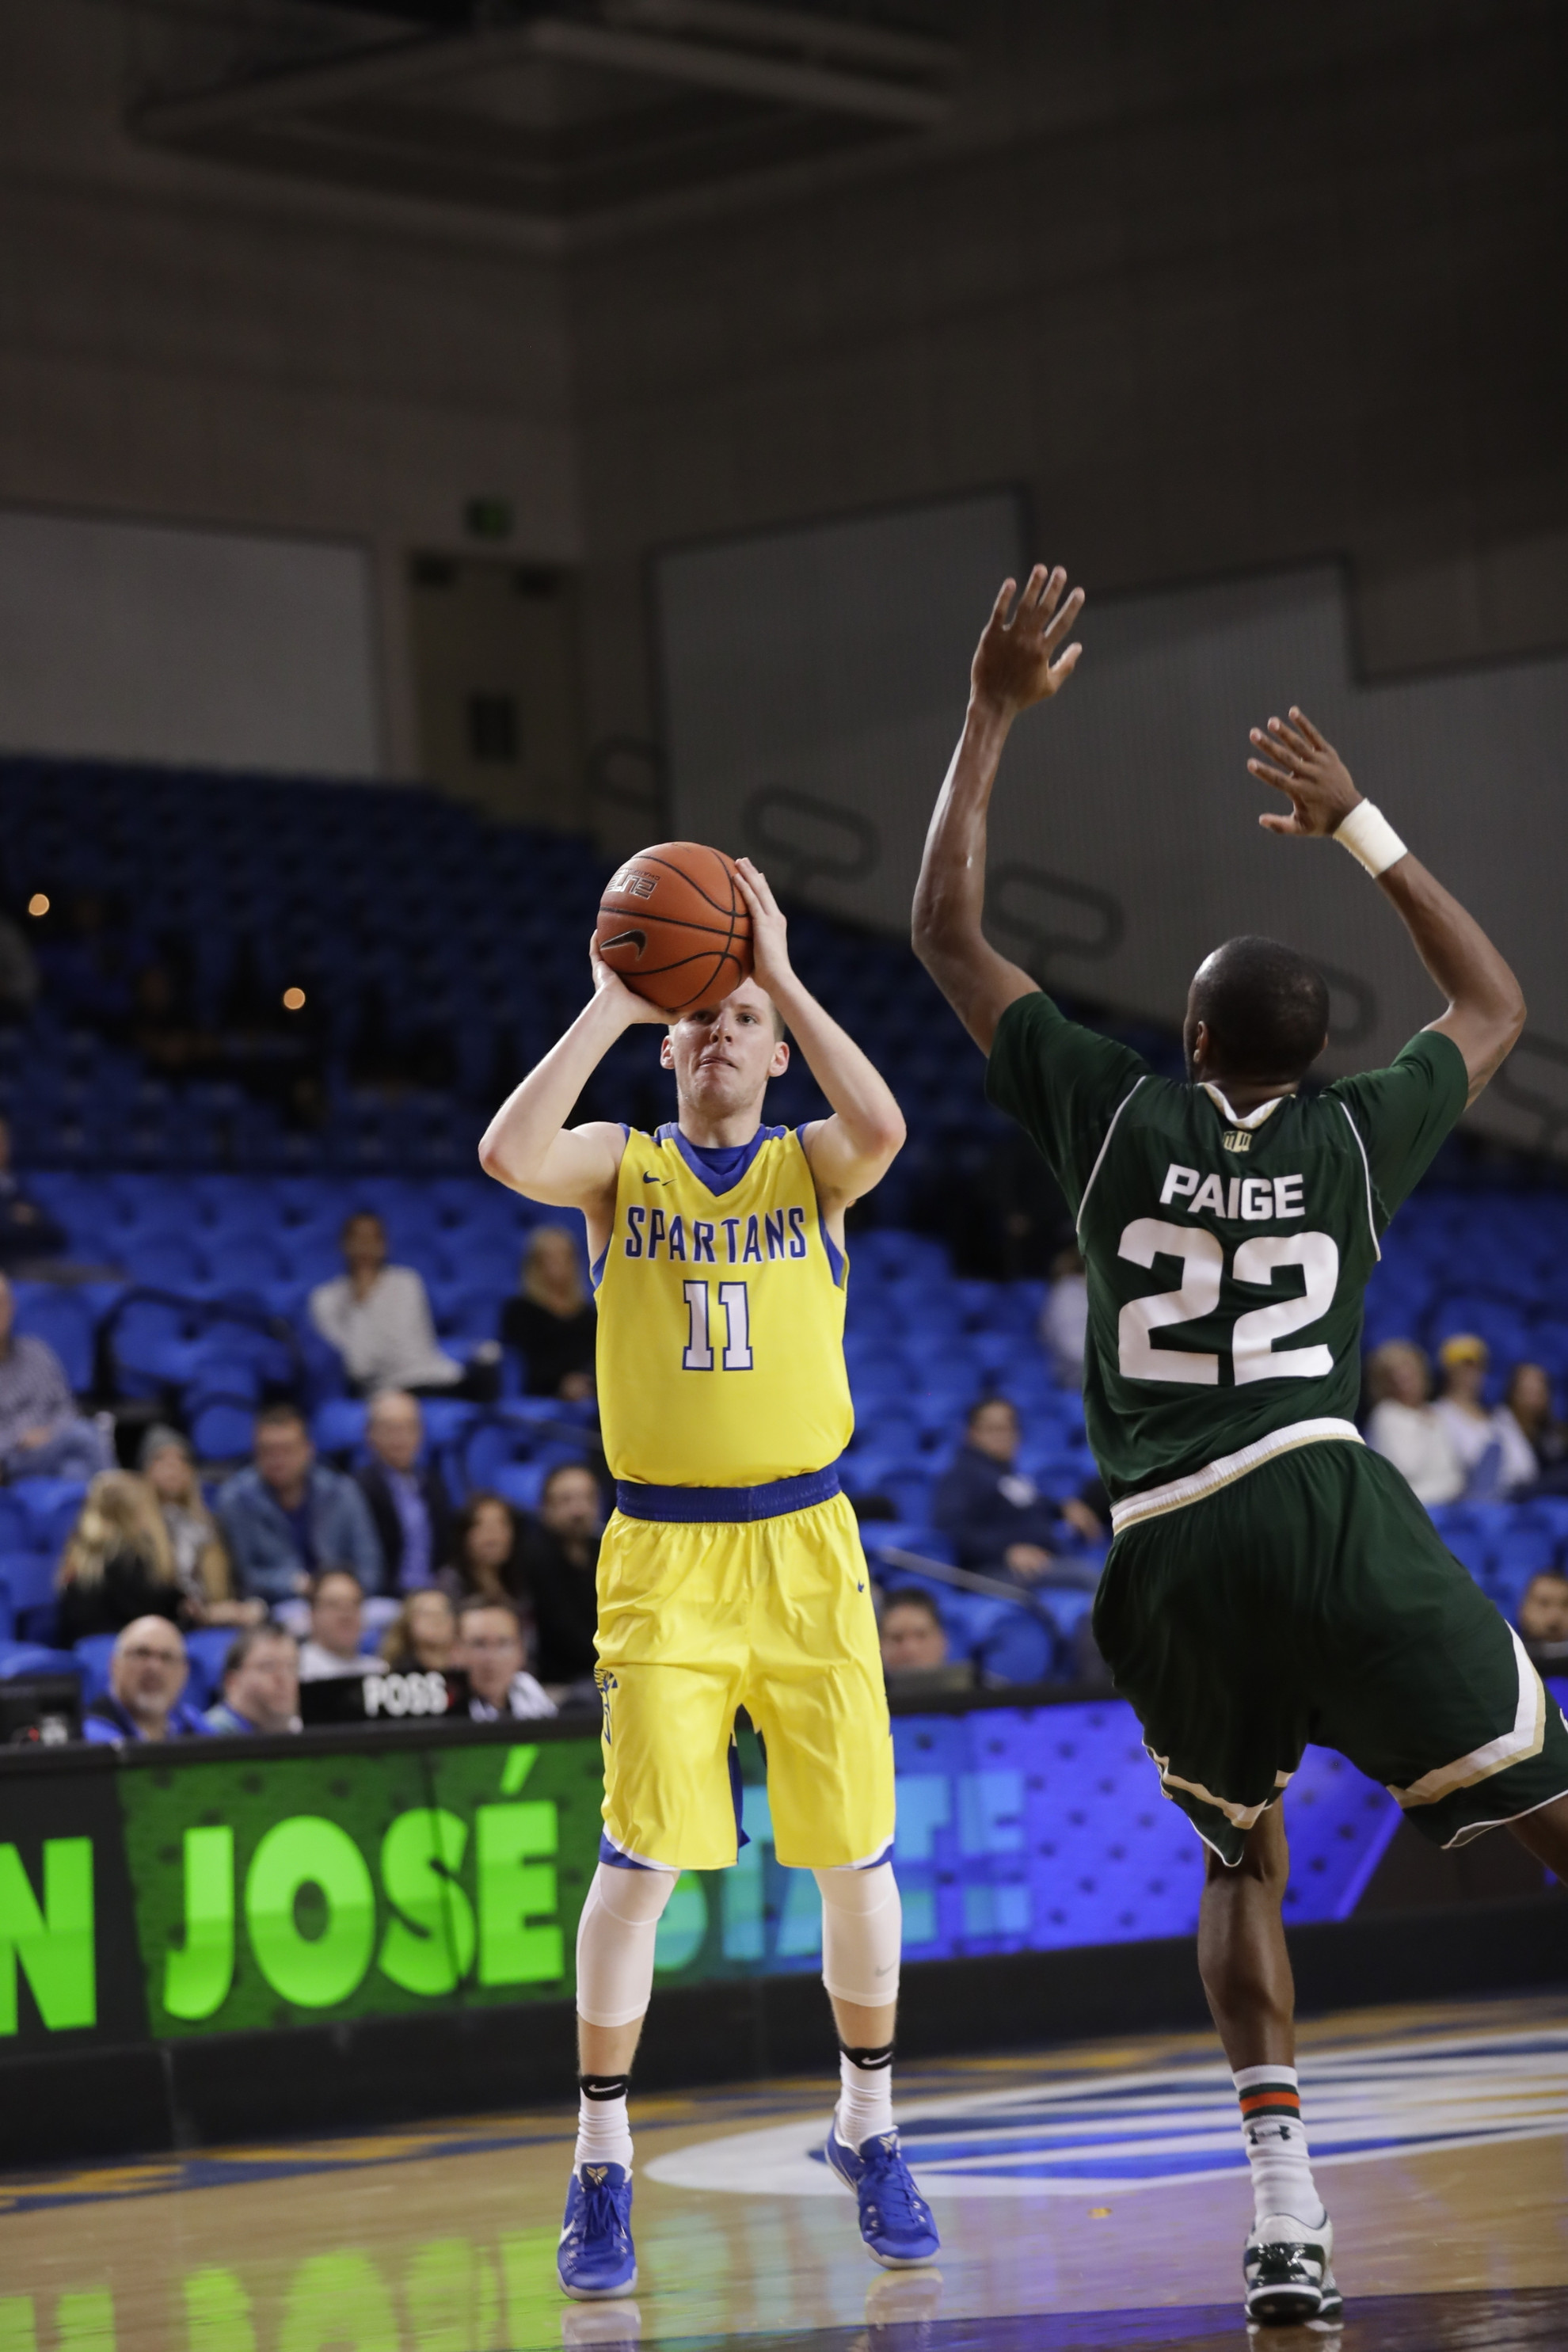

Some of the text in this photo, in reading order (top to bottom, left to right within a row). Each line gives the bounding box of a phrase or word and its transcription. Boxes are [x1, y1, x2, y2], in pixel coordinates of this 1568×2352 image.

[1159, 1163, 1306, 1220] PAIGE
[625, 1205, 807, 1264] SPARTANS
[682, 1279, 754, 1372] 11
[1117, 1217, 1339, 1386] 22
[363, 1671, 449, 1718] POSS
[163, 1745, 565, 2021] JOSÉ
